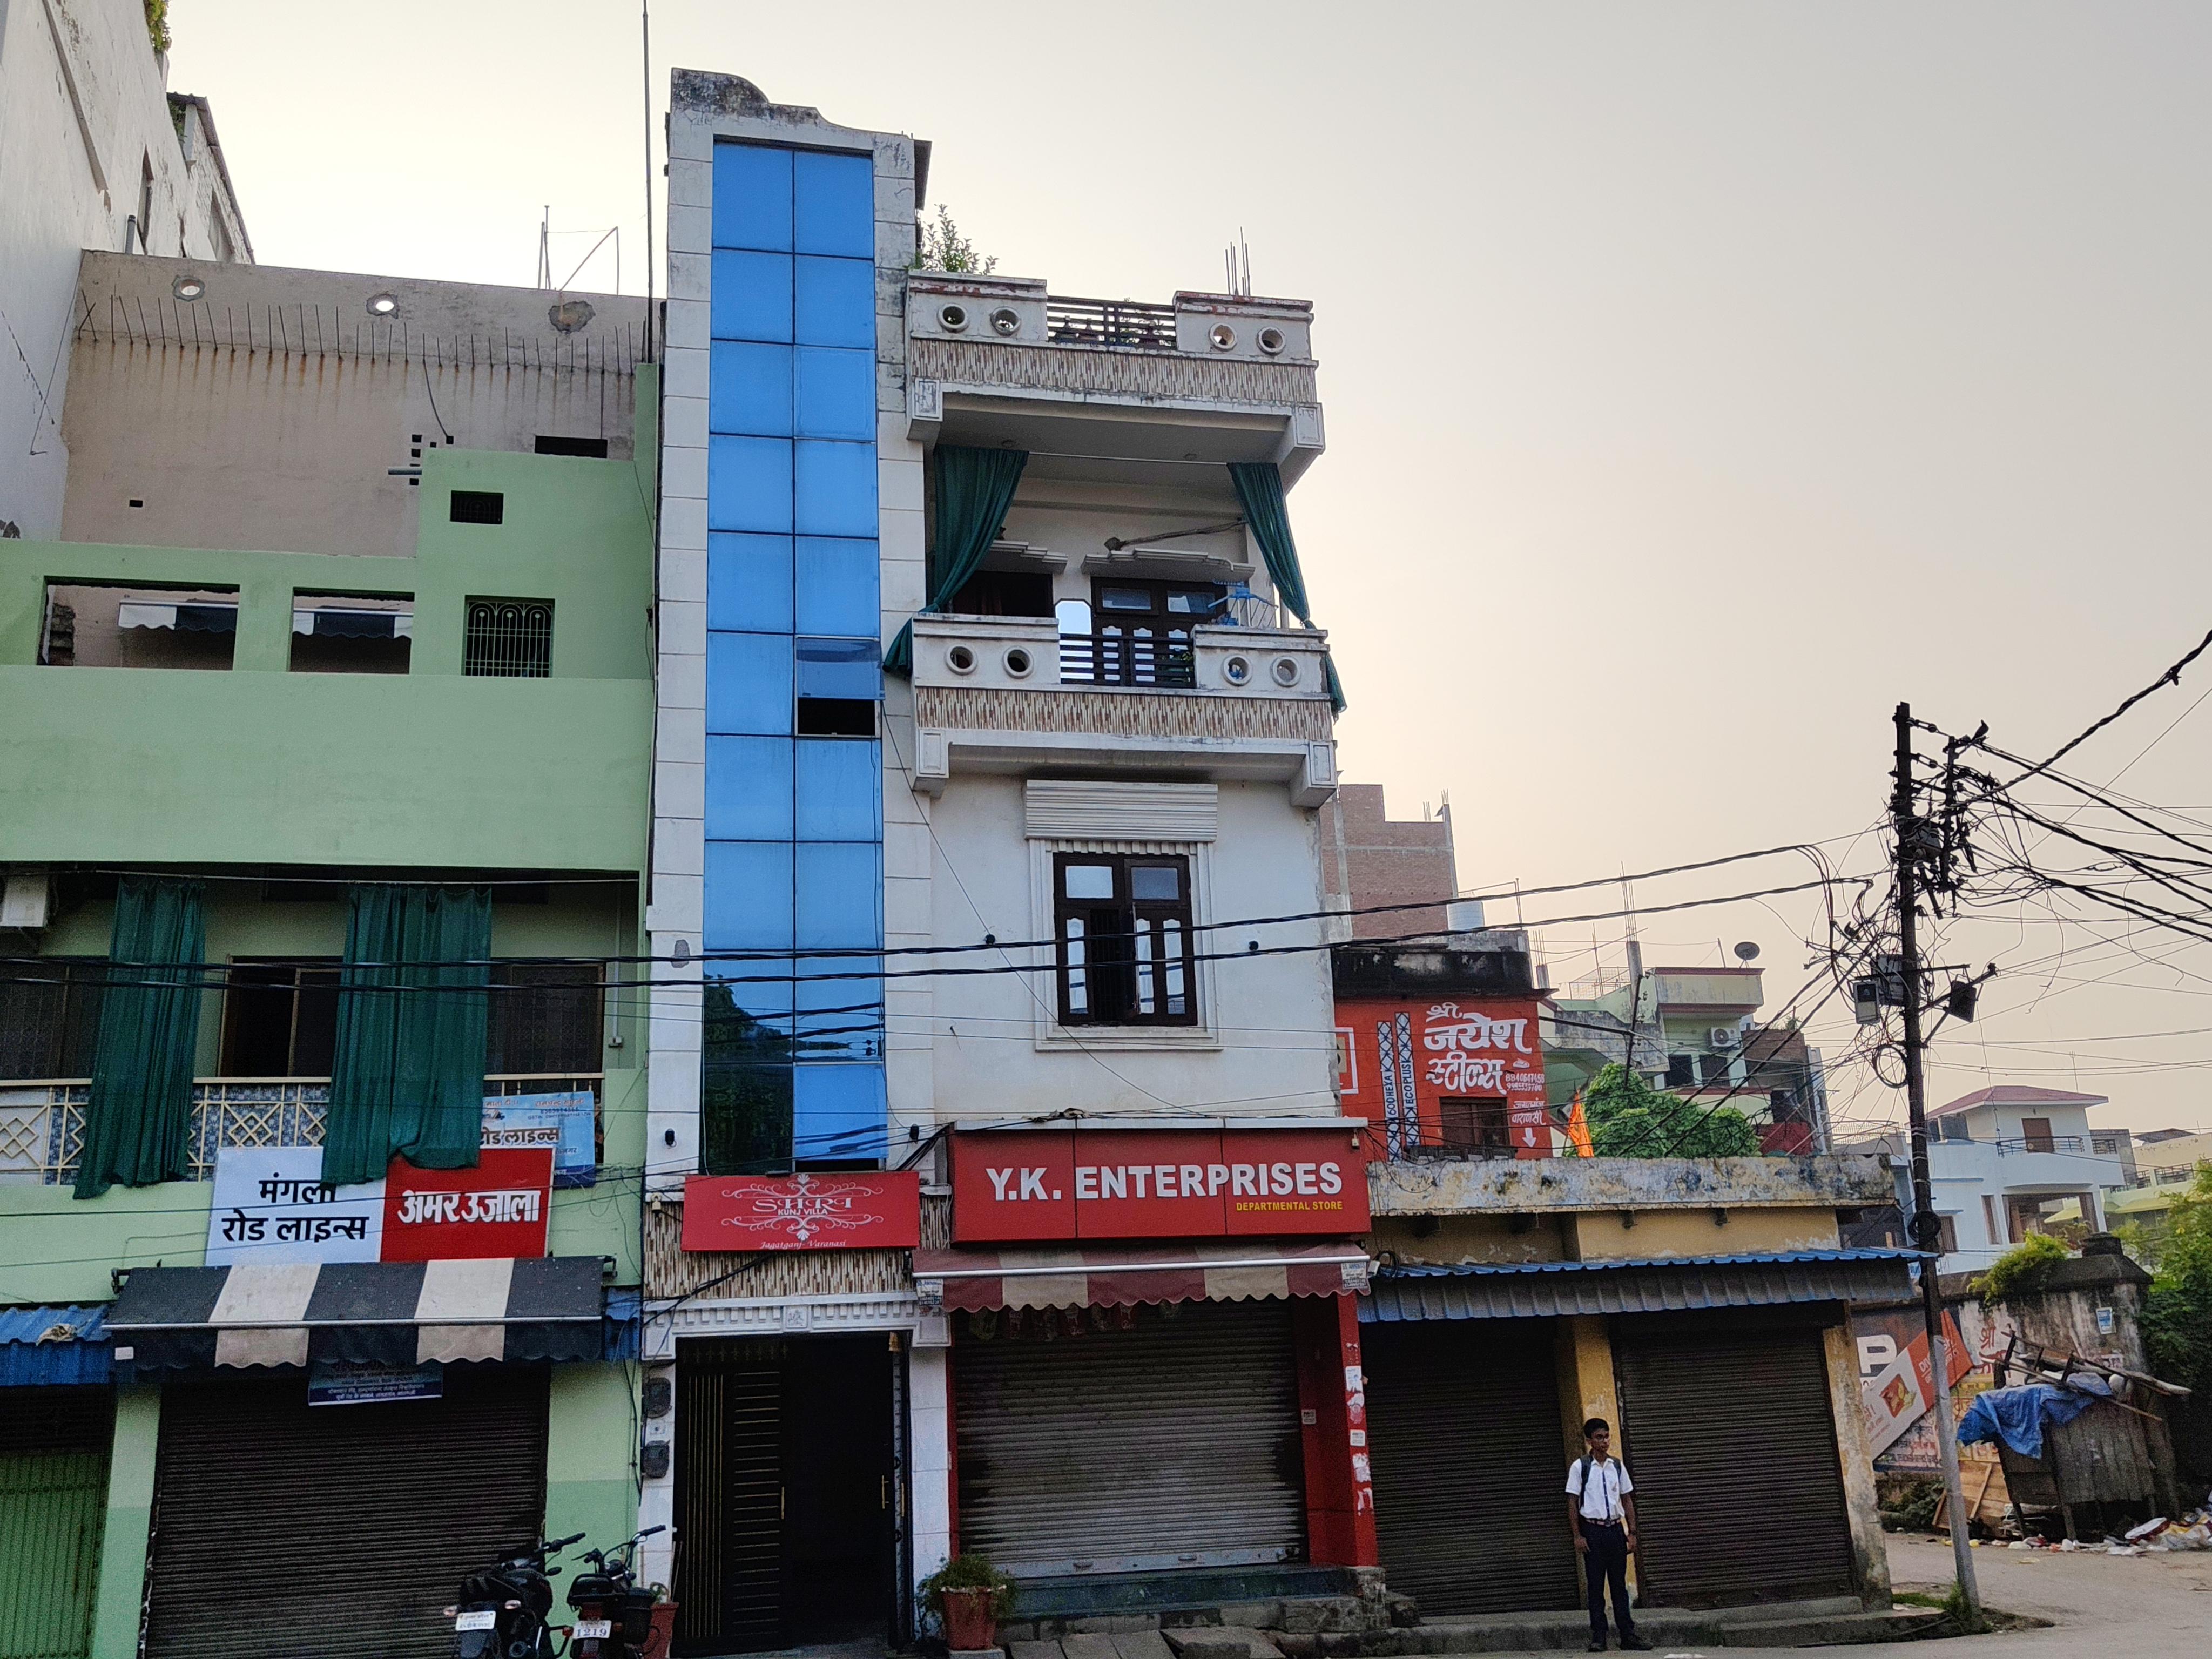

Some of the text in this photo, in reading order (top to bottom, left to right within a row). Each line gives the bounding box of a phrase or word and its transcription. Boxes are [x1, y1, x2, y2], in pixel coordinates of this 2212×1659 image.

[1426, 1002, 1462, 1023] श्री
[1424, 1012, 1532, 1054] जयेश
[986, 1162, 1343, 1201] Y.K. ENTERPRISES
[397, 1190, 541, 1223] अमर उजाला
[752, 1197, 852, 1212] SHRI
[1236, 1201, 1343, 1211] DEPARTMENTAL STORE
[221, 1208, 370, 1243] रोड लाइन्स
[577, 1628, 608, 1637] 1219
